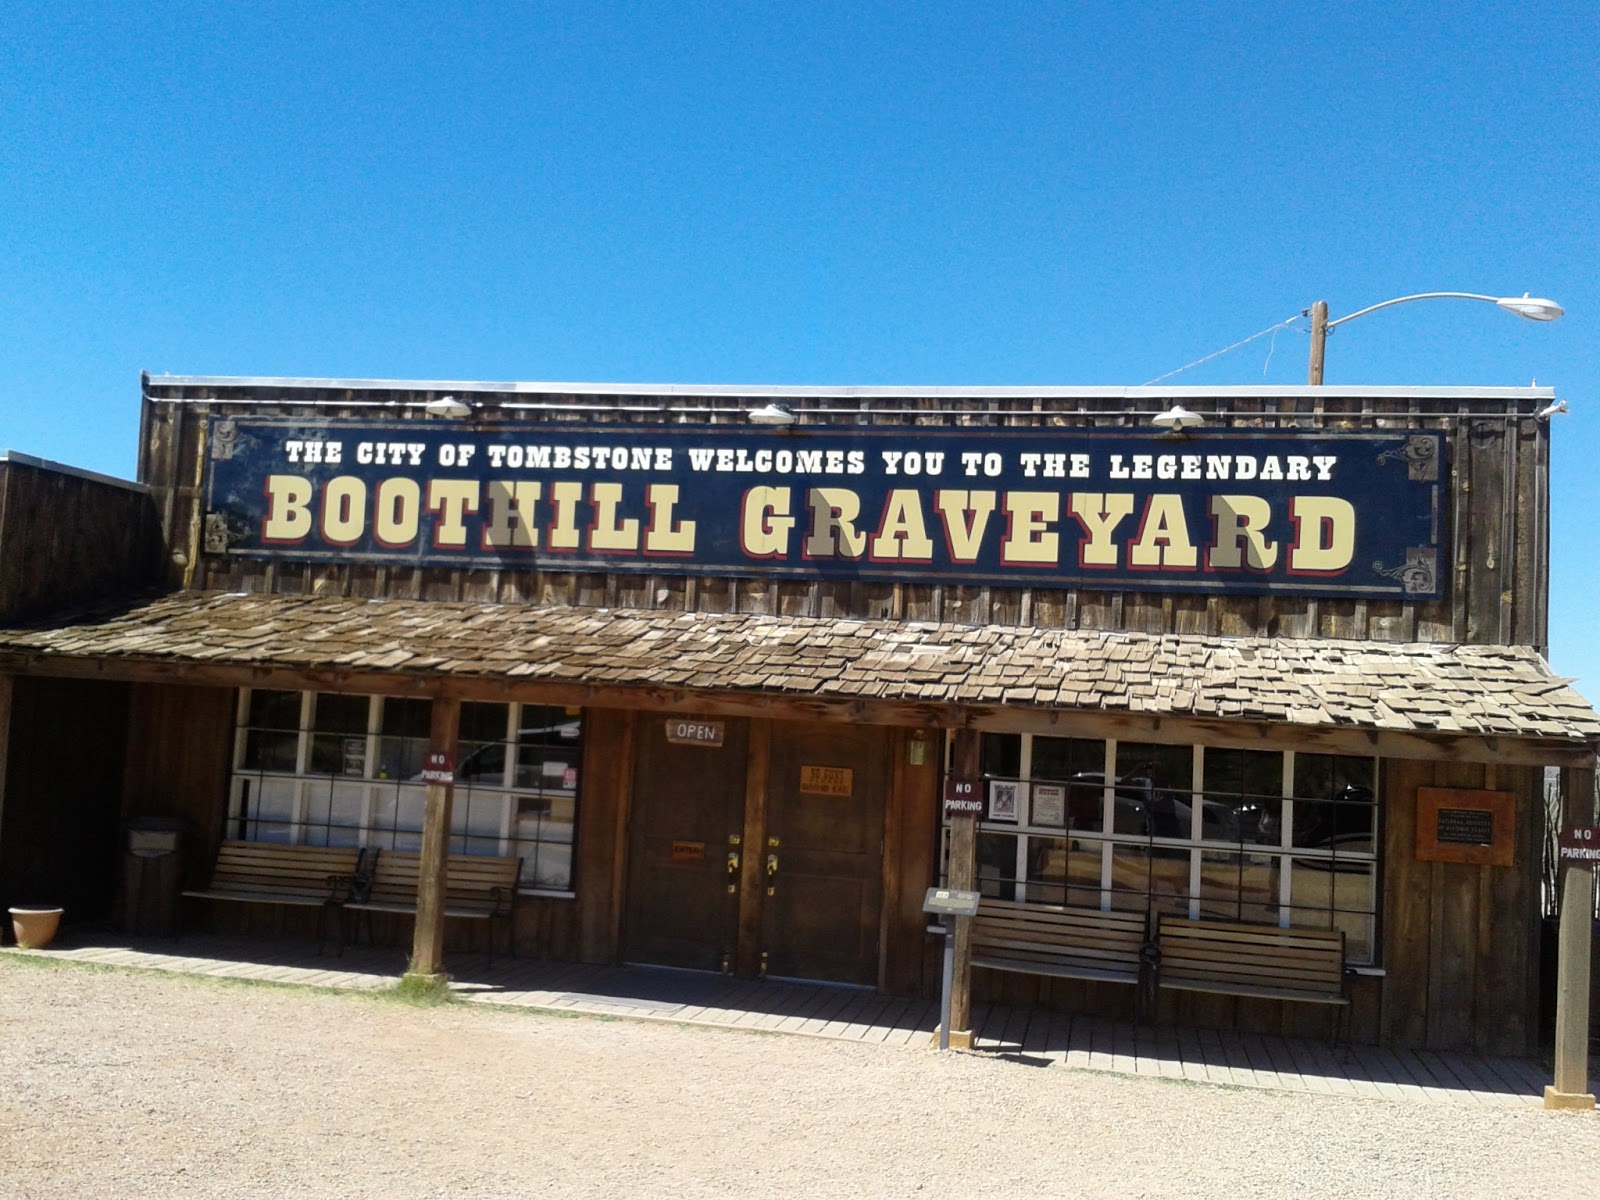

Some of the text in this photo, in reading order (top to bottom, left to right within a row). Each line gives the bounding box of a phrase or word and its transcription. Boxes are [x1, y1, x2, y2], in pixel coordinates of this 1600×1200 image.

[285, 440, 1338, 482] THE CITY OF TOMBSTONE WELCOMES YOU TO THE LEGENDARY
[264, 474, 1356, 573] BOOTHILL GRAVEYARD
[677, 723, 715, 740] OPEN
[431, 754, 445, 765] NO
[421, 769, 453, 782] PARKING
[956, 783, 971, 794] NO
[945, 799, 982, 811] PARKING
[1574, 829, 1592, 840] NO
[1560, 847, 1600, 859] PARKING
